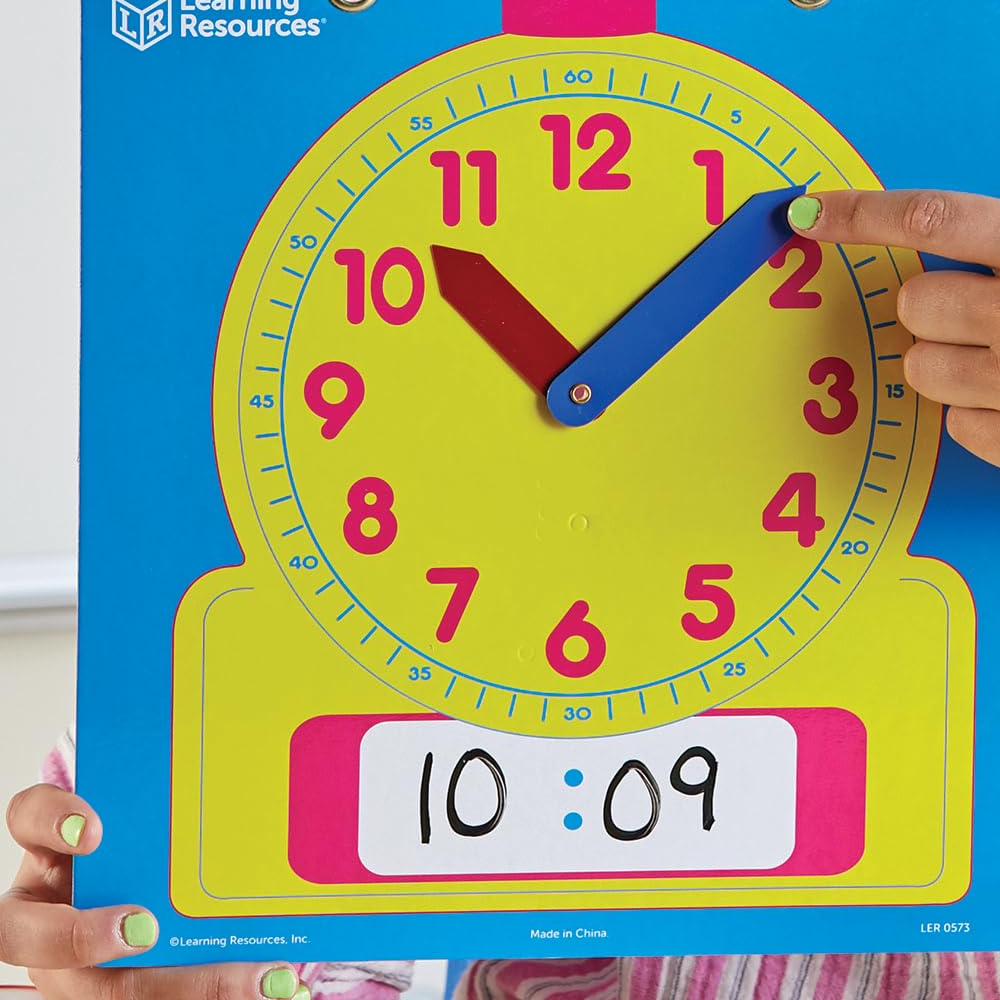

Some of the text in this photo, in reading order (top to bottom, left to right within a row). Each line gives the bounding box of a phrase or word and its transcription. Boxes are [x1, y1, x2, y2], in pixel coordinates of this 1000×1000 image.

[180, 13, 321, 37] Resources
[563, 69, 593, 84] 60
[409, 116, 433, 131] 55
[731, 109, 743, 125] 5
[539, 112, 632, 191] 12
[429, 150, 497, 227] 11
[693, 149, 724, 226] 1
[289, 234, 318, 250] 50
[767, 234, 823, 309] 2
[334, 246, 425, 326] 10
[802, 356, 859, 436] 3
[885, 384, 905, 398] 15
[249, 394, 275, 409] 45
[303, 361, 365, 440] 9
[343, 476, 398, 555] 8
[762, 472, 826, 548] 4
[841, 540, 869, 556] 20
[289, 555, 319, 570] 40
[426, 567, 480, 643] 7
[681, 564, 736, 641] 5
[545, 600, 607, 679] 6
[408, 666, 432, 681] 35
[723, 661, 747, 677] 25
[563, 706, 592, 722] 30
[530, 929, 560, 939] Made
[562, 928, 573, 938] in
[920, 922, 970, 933] LER 0573
[291, 933, 311, 944] Inc.
